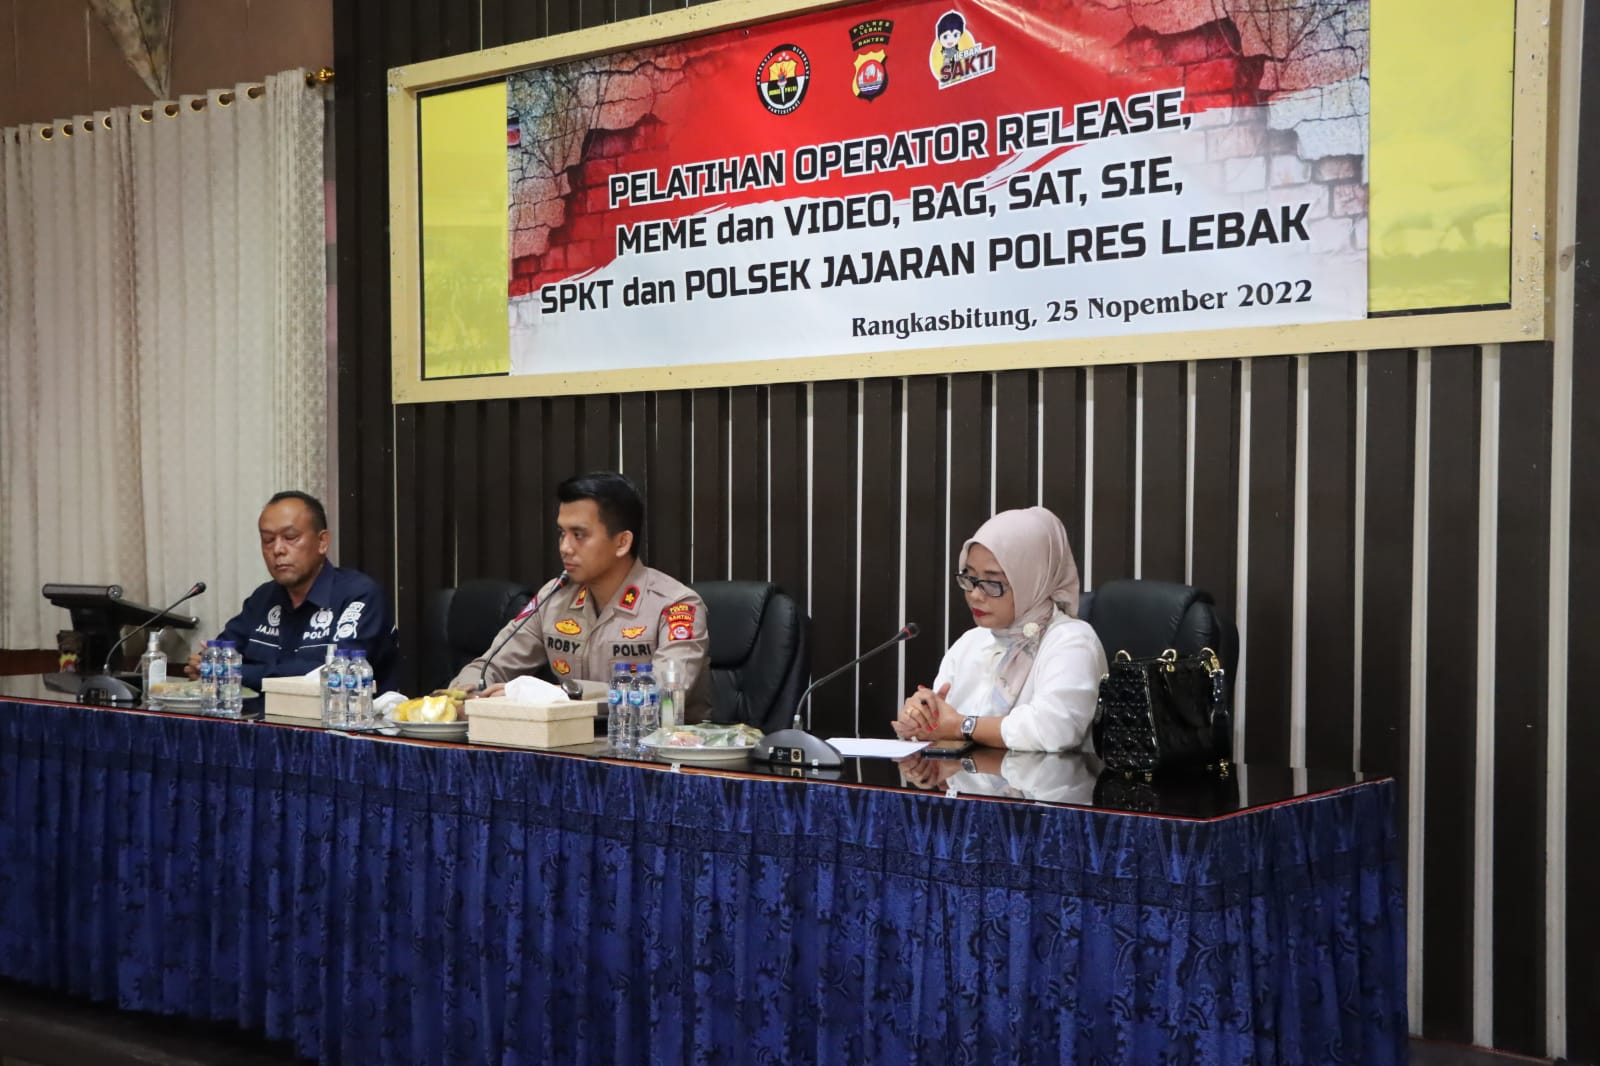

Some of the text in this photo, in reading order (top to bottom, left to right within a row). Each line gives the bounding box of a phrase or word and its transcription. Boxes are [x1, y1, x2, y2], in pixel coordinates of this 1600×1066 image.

[852, 21, 891, 33] POLRES
[940, 49, 994, 83] SAKTI
[610, 91, 1191, 206] PELATIHAN OPERATOR RELEASE,
[618, 156, 1183, 256] MEME dan VIDEO, BAG, SAT, SIE,
[541, 203, 1310, 314] SPKT dan POLSEK JAJARAN POLRES LEBAK
[851, 279, 1313, 340] Rangkasbitung, 25 Nopember 2022
[547, 636, 580, 655] ROBY
[612, 643, 652, 657] POLRI
